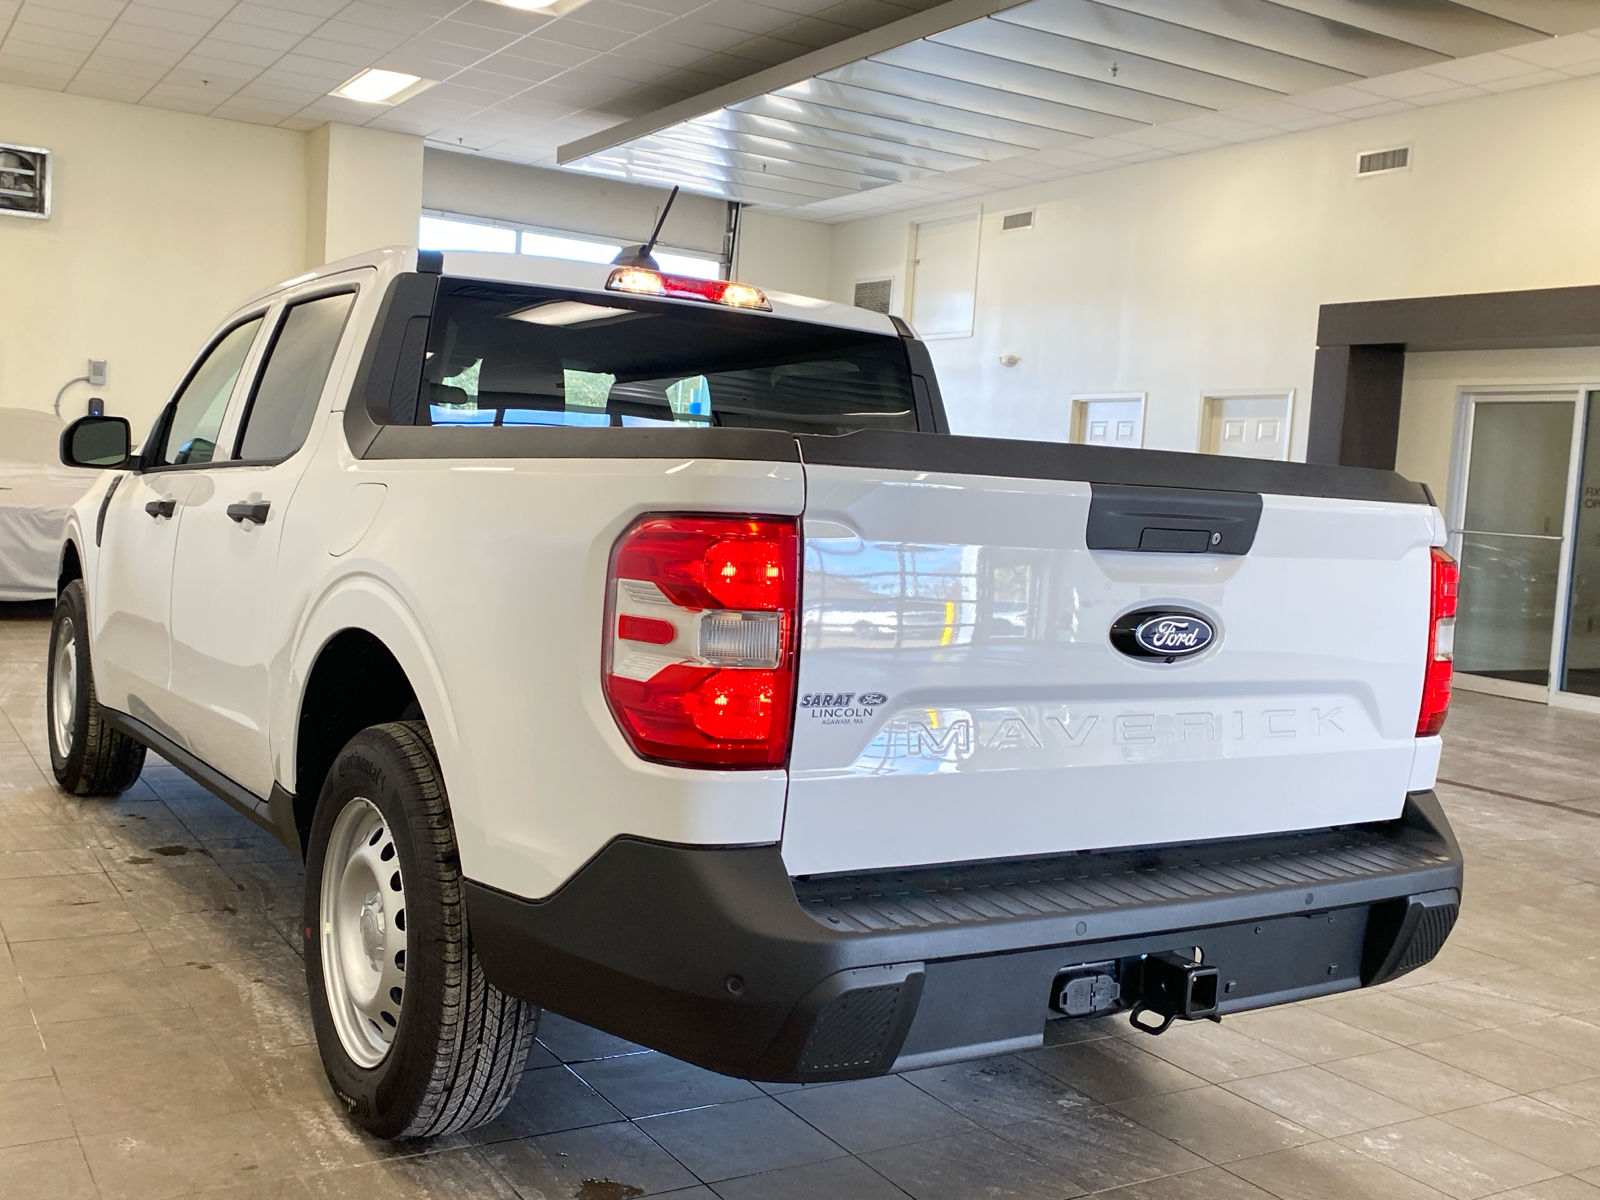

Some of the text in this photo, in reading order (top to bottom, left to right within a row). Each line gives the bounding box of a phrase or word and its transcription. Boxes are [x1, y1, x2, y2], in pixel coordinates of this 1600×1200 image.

[1153, 621, 1199, 646] Ford
[800, 693, 883, 708] SARAT Ford
[811, 708, 873, 718] LINCOLN
[907, 706, 1347, 756] MAVERICK
[338, 751, 382, 786] Continental
